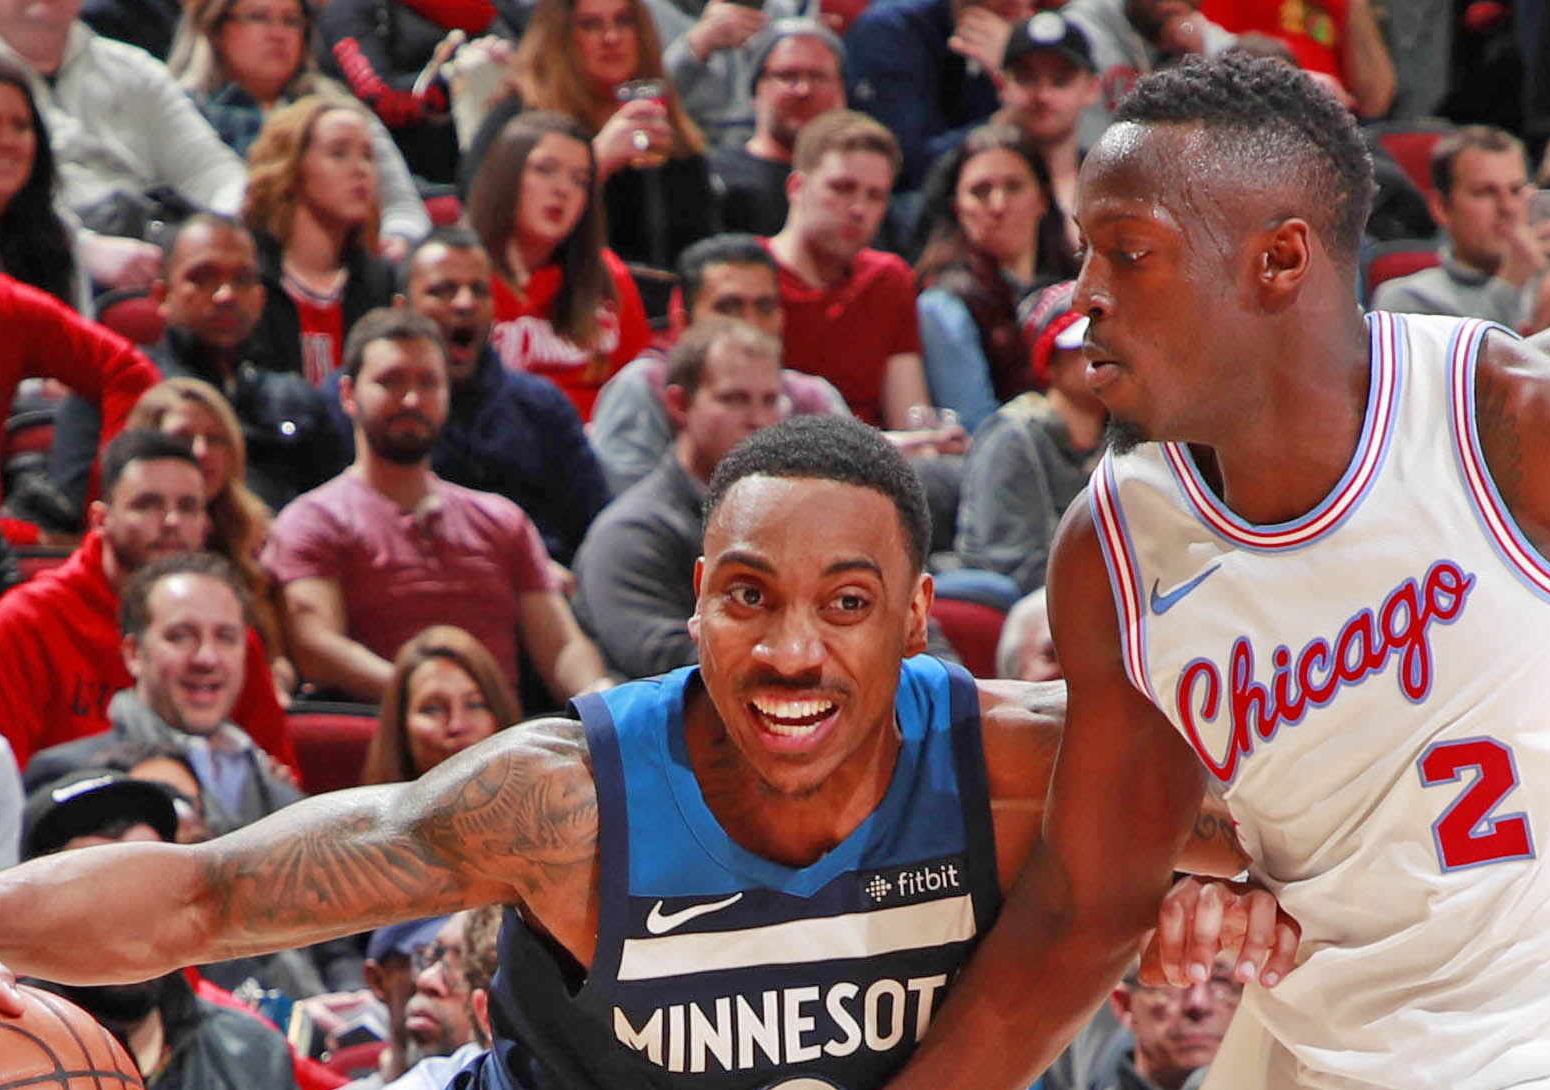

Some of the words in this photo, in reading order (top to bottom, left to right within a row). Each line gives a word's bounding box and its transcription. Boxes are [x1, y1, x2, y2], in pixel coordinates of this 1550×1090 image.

[1176, 559, 1477, 786] Chicago
[1416, 735, 1536, 873] 2
[898, 864, 960, 896] fitbit
[613, 972, 958, 1073] MINNESOT
